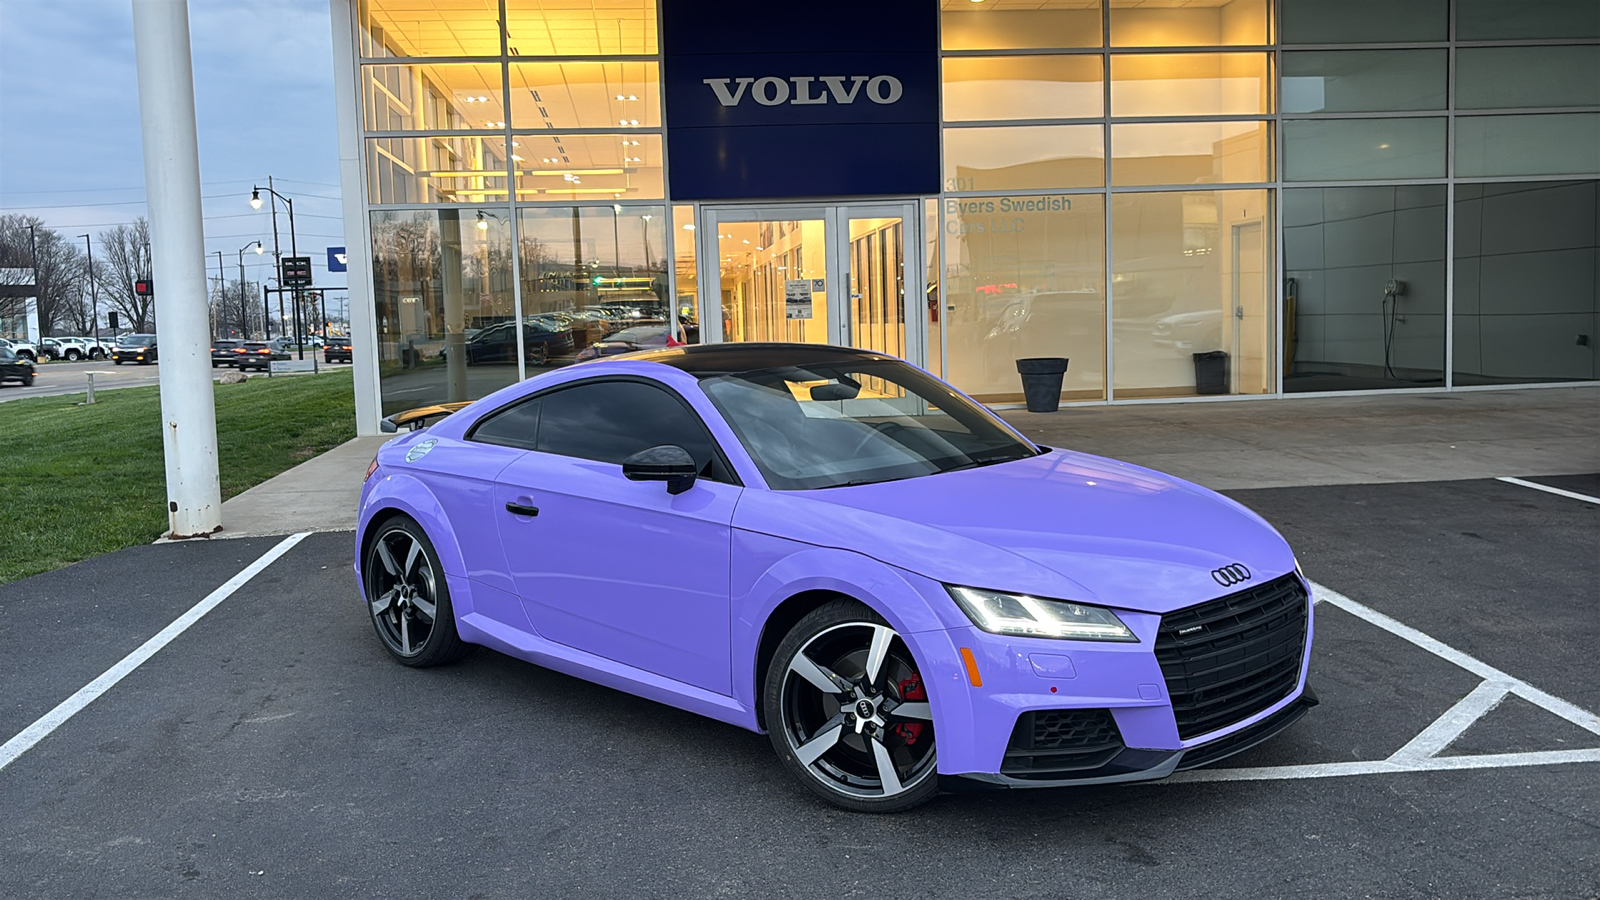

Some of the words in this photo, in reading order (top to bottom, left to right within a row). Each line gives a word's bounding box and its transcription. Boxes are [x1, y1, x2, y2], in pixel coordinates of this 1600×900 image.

[703, 75, 903, 106] VOLVO
[946, 177, 974, 192] 301
[946, 199, 995, 216] Byers
[1000, 197, 1072, 213] Swedish
[946, 219, 985, 235] Cars
[992, 217, 1025, 233] LLC
